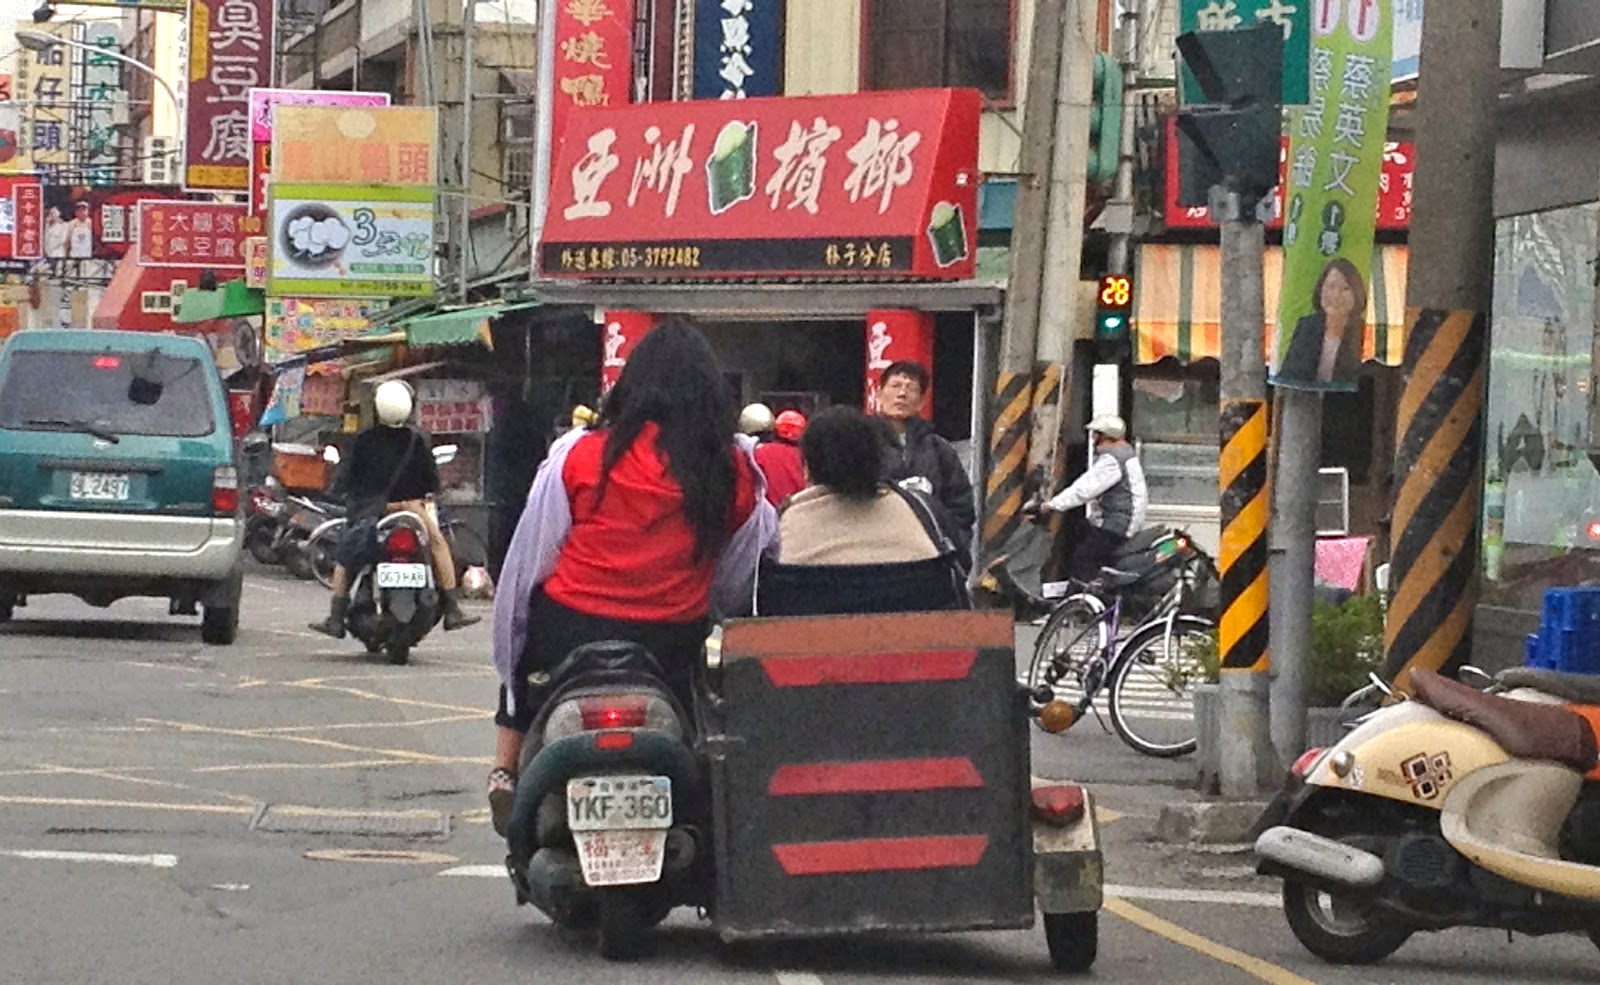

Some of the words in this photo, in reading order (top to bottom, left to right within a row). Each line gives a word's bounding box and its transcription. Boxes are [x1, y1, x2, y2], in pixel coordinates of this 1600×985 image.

[1323, 53, 1375, 197] 蔡英文
[1102, 277, 1130, 305] 28
[570, 794, 670, 821] YKF-360
